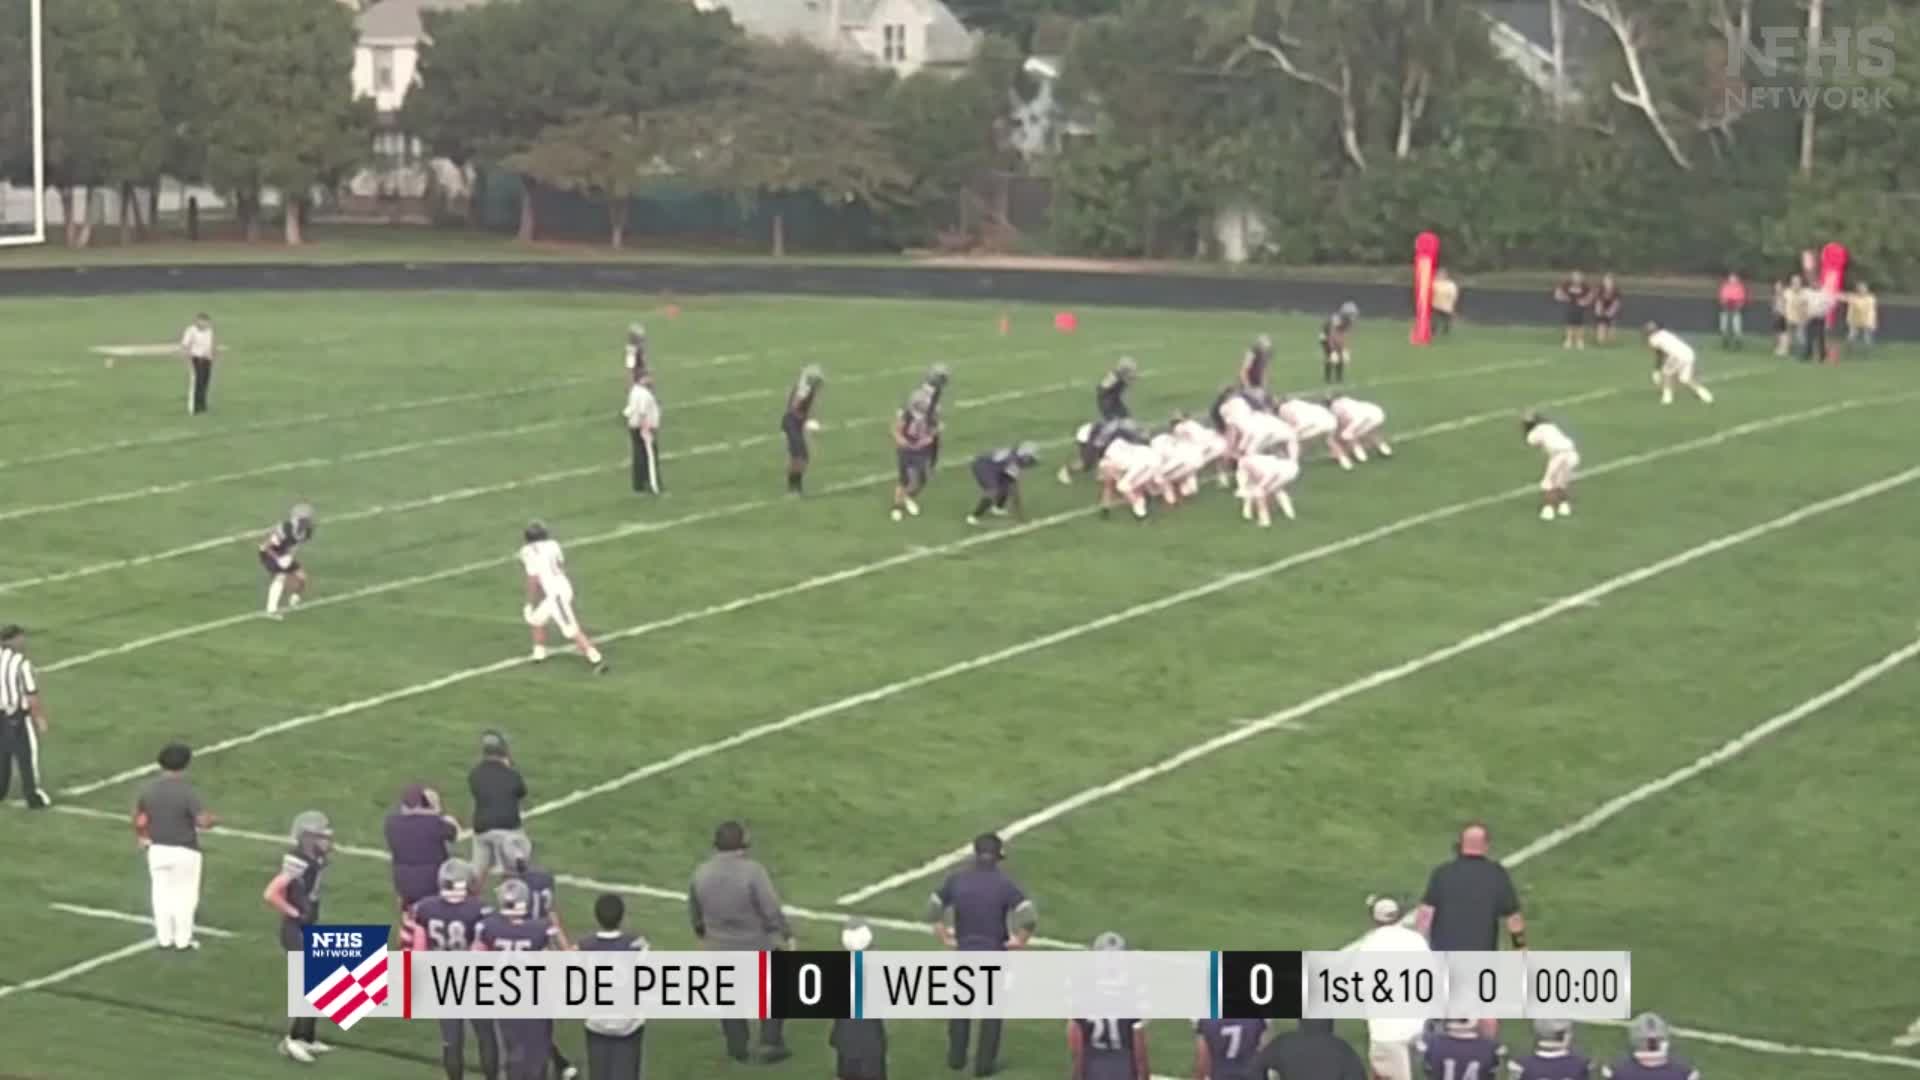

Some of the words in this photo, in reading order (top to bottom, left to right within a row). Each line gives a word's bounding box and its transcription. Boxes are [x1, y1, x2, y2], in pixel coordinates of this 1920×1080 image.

[428, 919, 467, 951] 58
[1088, 1018, 1121, 1049] 21
[1220, 1024, 1243, 1059] 7
